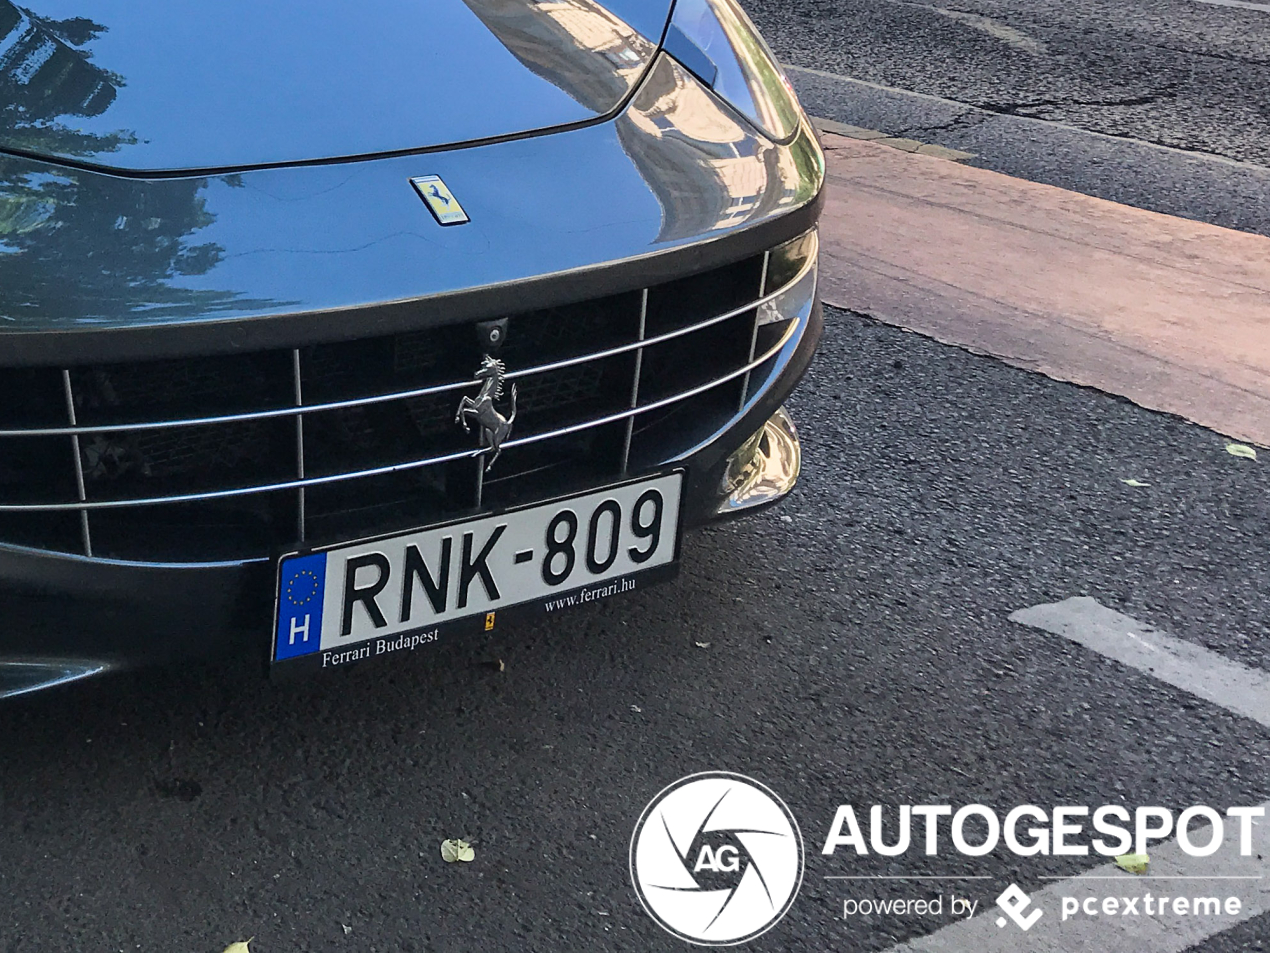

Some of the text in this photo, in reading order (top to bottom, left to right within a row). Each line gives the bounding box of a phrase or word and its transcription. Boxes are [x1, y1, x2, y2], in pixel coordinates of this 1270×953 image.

[340, 487, 664, 637] RNK-809
[545, 578, 636, 613] www.ferrari.hu
[288, 614, 311, 645] H
[322, 628, 439, 668] Ferrari Budapest
